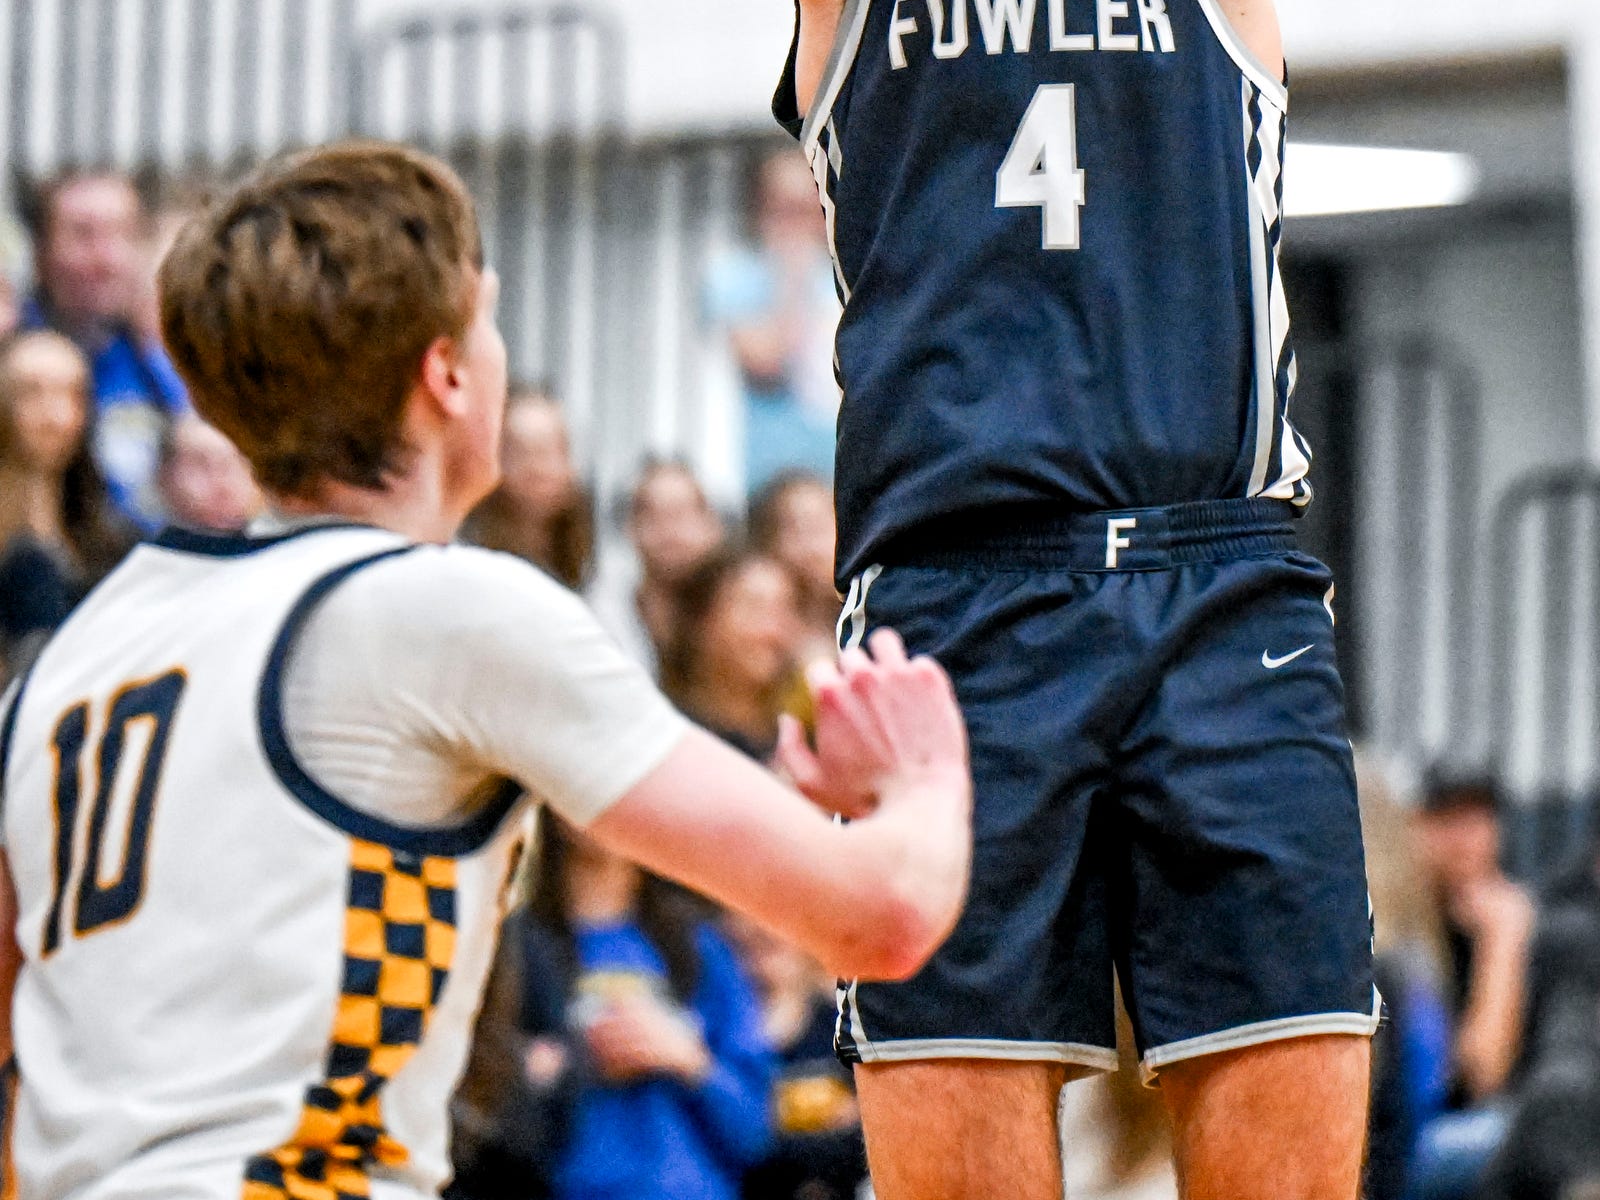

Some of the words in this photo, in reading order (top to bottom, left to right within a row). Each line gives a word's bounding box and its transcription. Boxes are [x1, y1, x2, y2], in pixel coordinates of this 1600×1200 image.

[994, 83, 1085, 249] 4
[1106, 518, 1136, 568] F
[40, 665, 189, 960] 10
